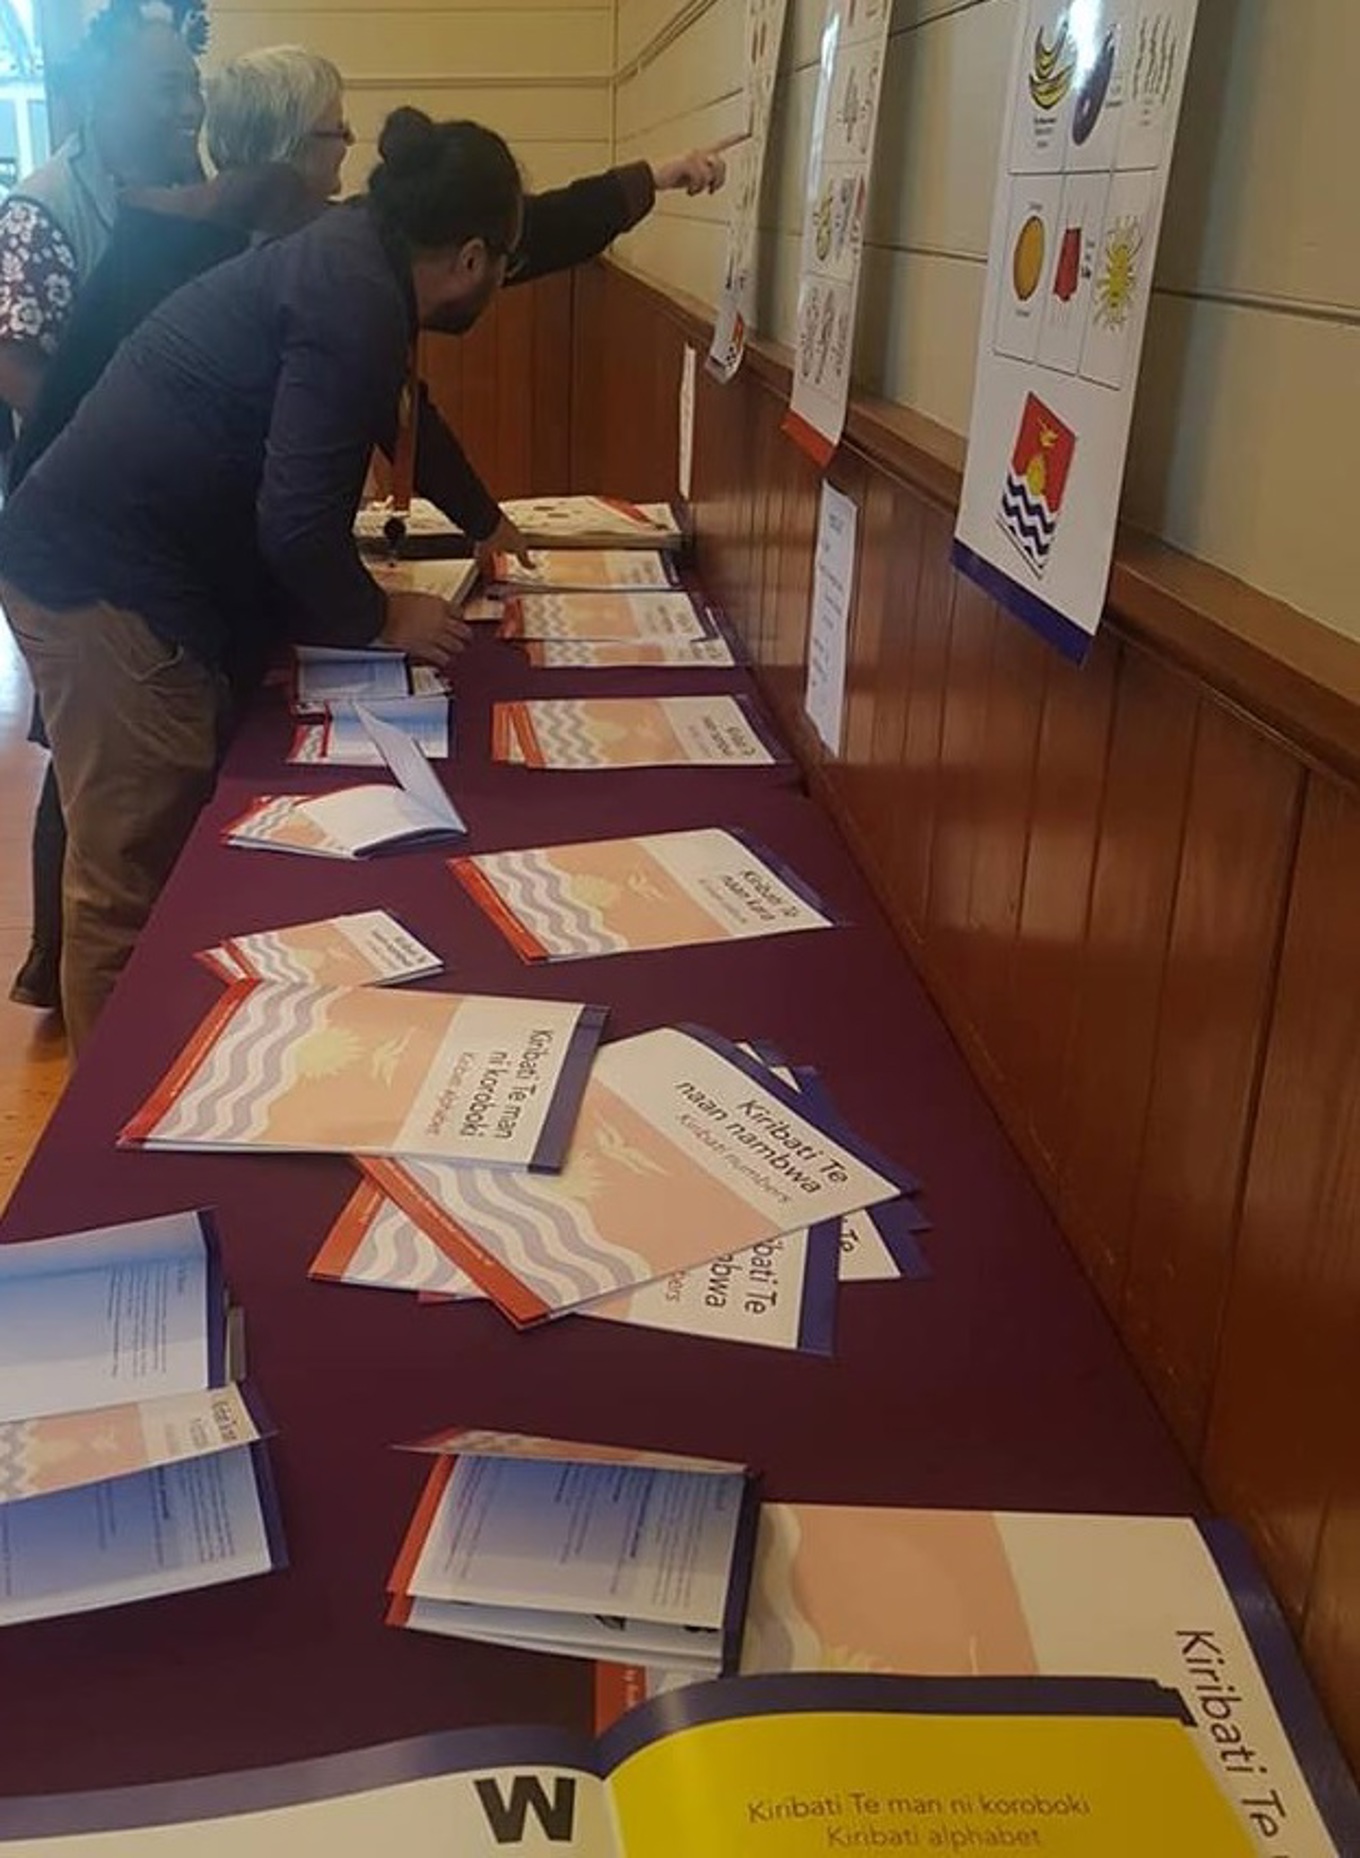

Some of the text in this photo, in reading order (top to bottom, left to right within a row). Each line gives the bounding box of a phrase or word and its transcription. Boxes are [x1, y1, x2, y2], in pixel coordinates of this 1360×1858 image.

[460, 1052, 512, 1137] ni koroboki
[494, 1029, 554, 1139] Kiribati Te man
[677, 1081, 822, 1194] naan nambwa
[738, 1100, 849, 1184] Kiribati Te
[744, 1291, 777, 1314] Te
[1175, 1630, 1286, 1837] Kiribati Te
[473, 1774, 577, 1845] W
[747, 1791, 1092, 1823] Kiribati Te man ni koroboki
[826, 1825, 1041, 1852] Kiribati alphabet
